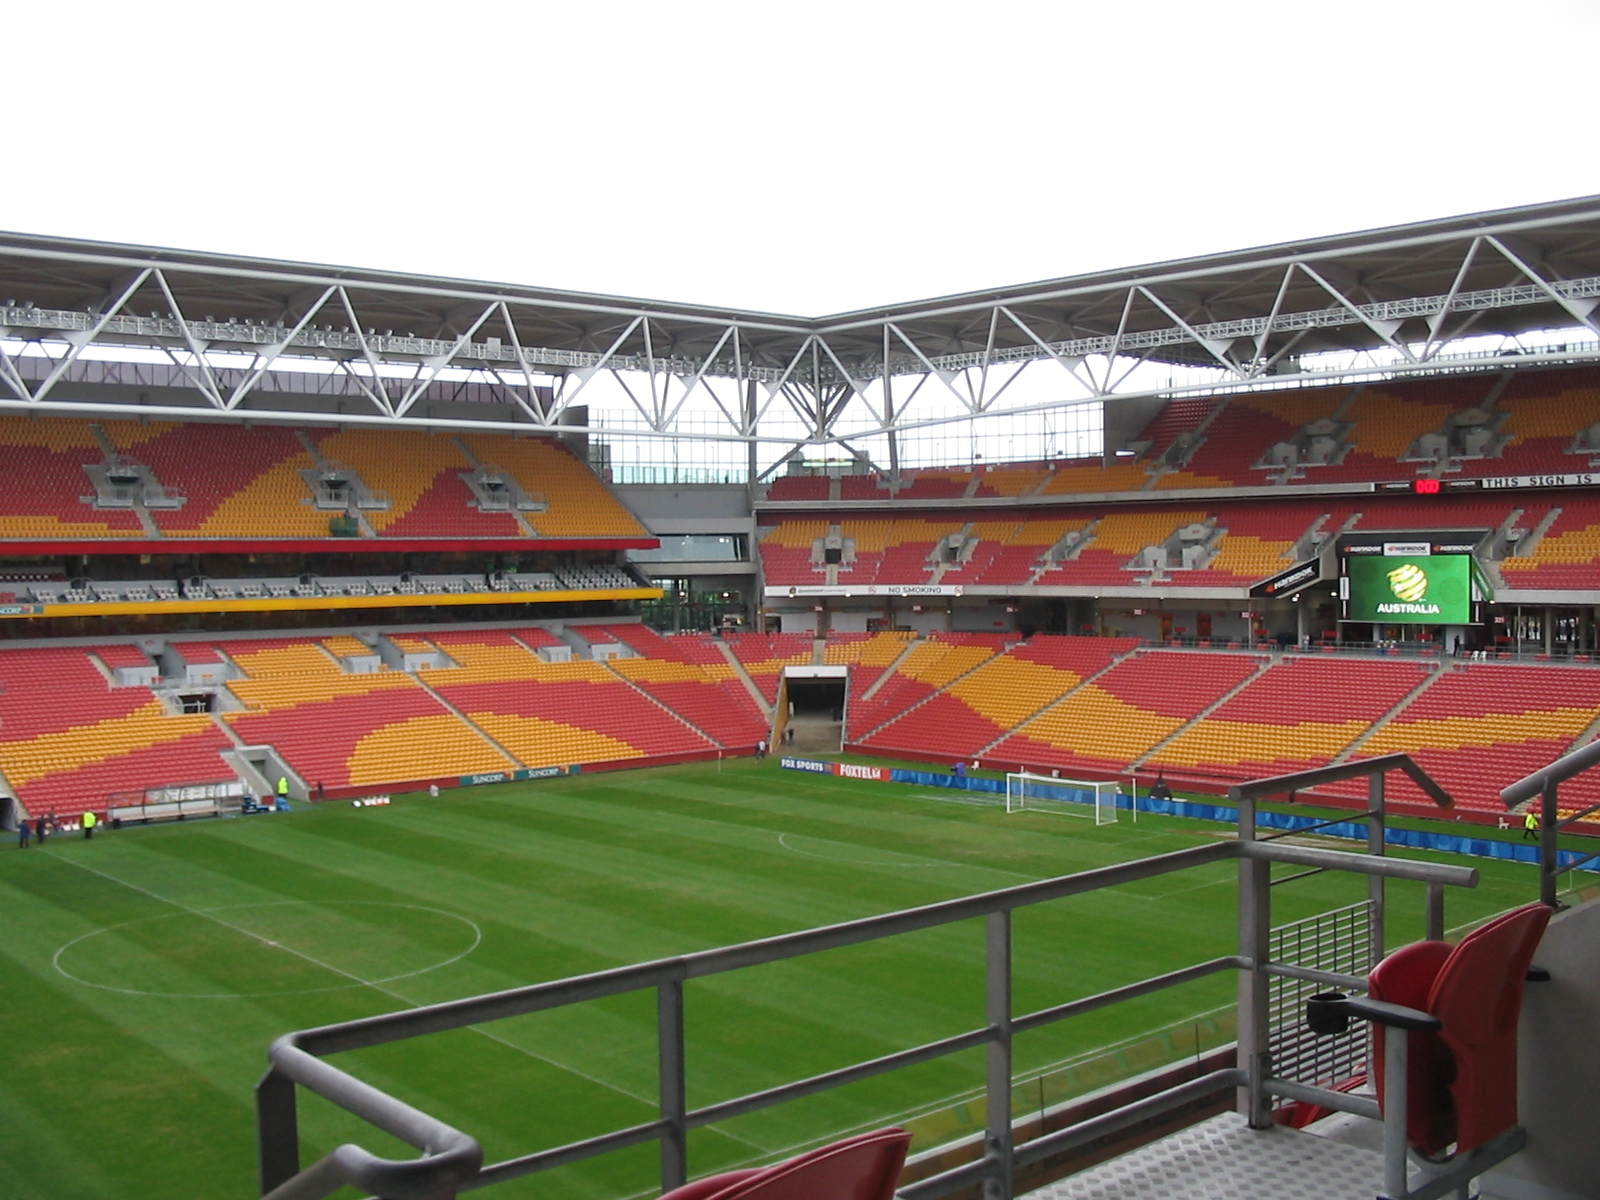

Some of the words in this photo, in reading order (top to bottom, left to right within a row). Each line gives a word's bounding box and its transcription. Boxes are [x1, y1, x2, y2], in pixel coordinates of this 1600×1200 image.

[1486, 478, 1519, 488] THIS
[1529, 476, 1565, 487] SIGN
[1577, 474, 1592, 485] IS
[1377, 603, 1440, 614] AUSTRALIA
[781, 758, 796, 769] FOX
[796, 760, 824, 772] SPORTS
[528, 767, 559, 778] SUNCORP
[840, 764, 873, 779] FOXTEL
[472, 773, 504, 784] SUNCORP
